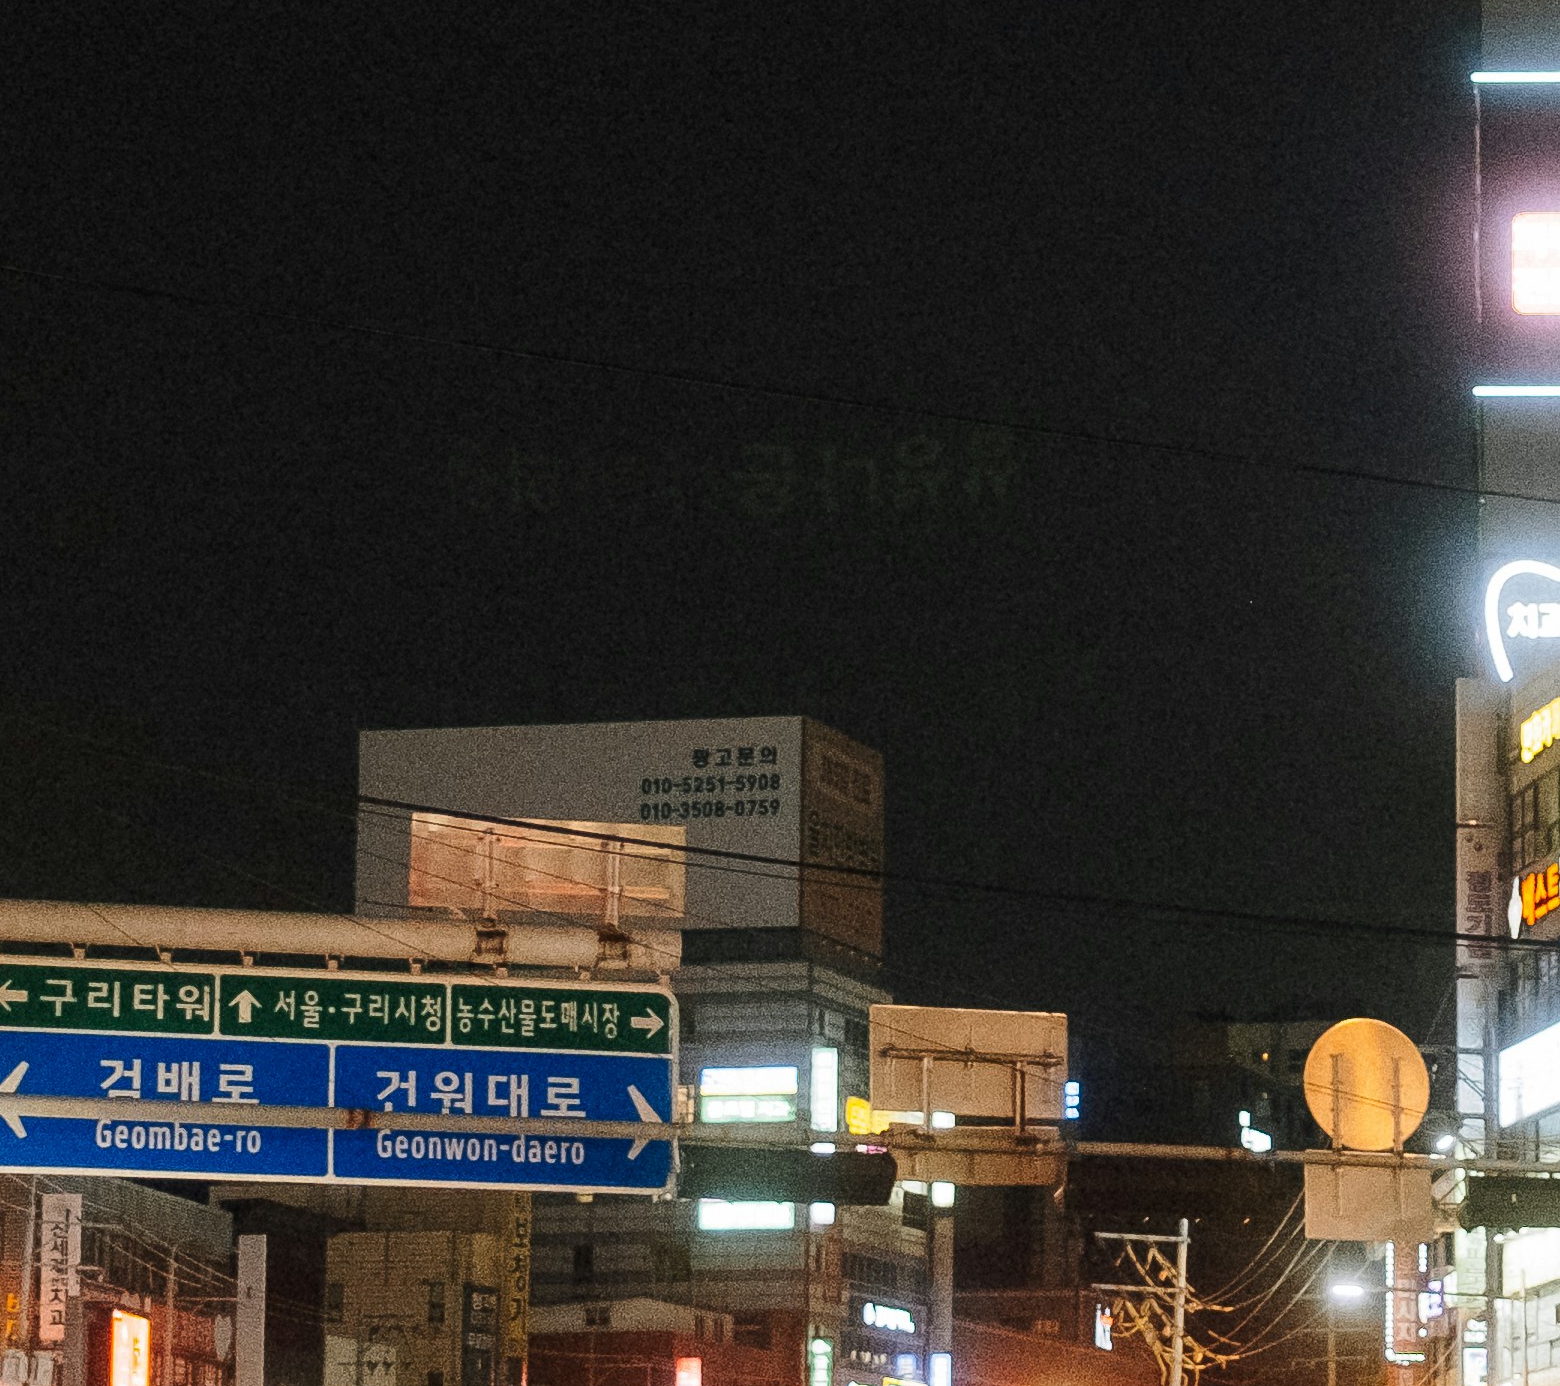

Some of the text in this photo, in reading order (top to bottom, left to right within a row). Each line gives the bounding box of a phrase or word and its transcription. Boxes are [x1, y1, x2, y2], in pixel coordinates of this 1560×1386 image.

[692, 745, 780, 767] 광고문의
[640, 772, 782, 796] 010-5251-5908
[640, 799, 782, 822] 010-3508-0759
[40, 978, 621, 1039] 구리타워 서울·구리시청 농수산물도매시장
[98, 1056, 588, 1123] 검배로 건원대로
[94, 1117, 586, 1168] Geombae-ro Geonwon-daero
